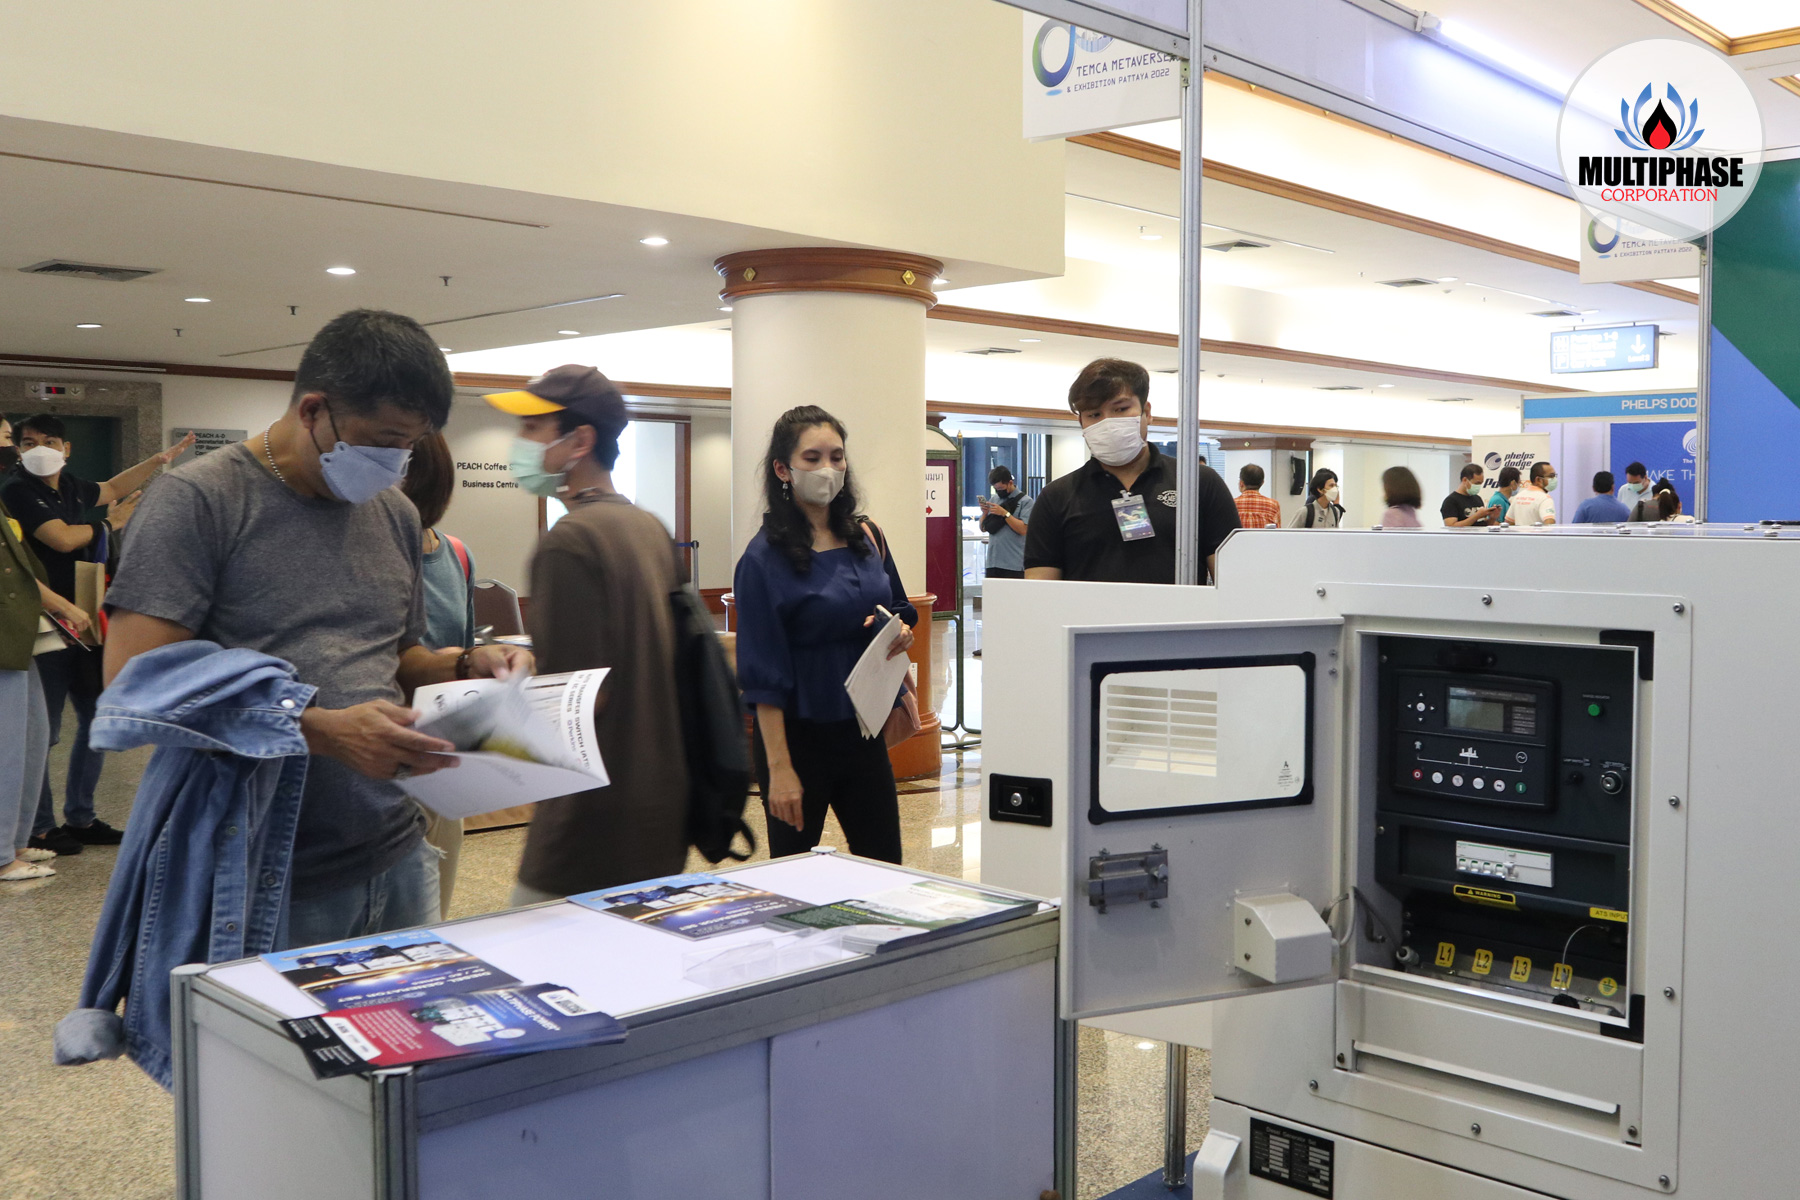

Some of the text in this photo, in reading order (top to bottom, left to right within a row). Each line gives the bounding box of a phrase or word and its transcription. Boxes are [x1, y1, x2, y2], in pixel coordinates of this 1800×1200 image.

[1076, 62, 1108, 77] TEMCA
[1074, 79, 1116, 92] EXHIBITION
[1118, 73, 1149, 84] PATTAYA
[1150, 68, 1170, 79] 2022
[1621, 241, 1646, 249] TEMCA
[1619, 250, 1652, 258] EXHIBITION
[1621, 397, 1697, 410] PHELPS DOD
[1504, 452, 1535, 461] phelps
[456, 462, 482, 470] PEACH
[484, 463, 507, 471] Coffee
[1504, 459, 1532, 470] dodge
[1681, 469, 1697, 481] TH
[462, 480, 519, 489] Business Centre
[926, 489, 936, 500] IC
[1439, 945, 1452, 962] L1
[1475, 952, 1490, 969] L2
[1513, 959, 1528, 977] L3
